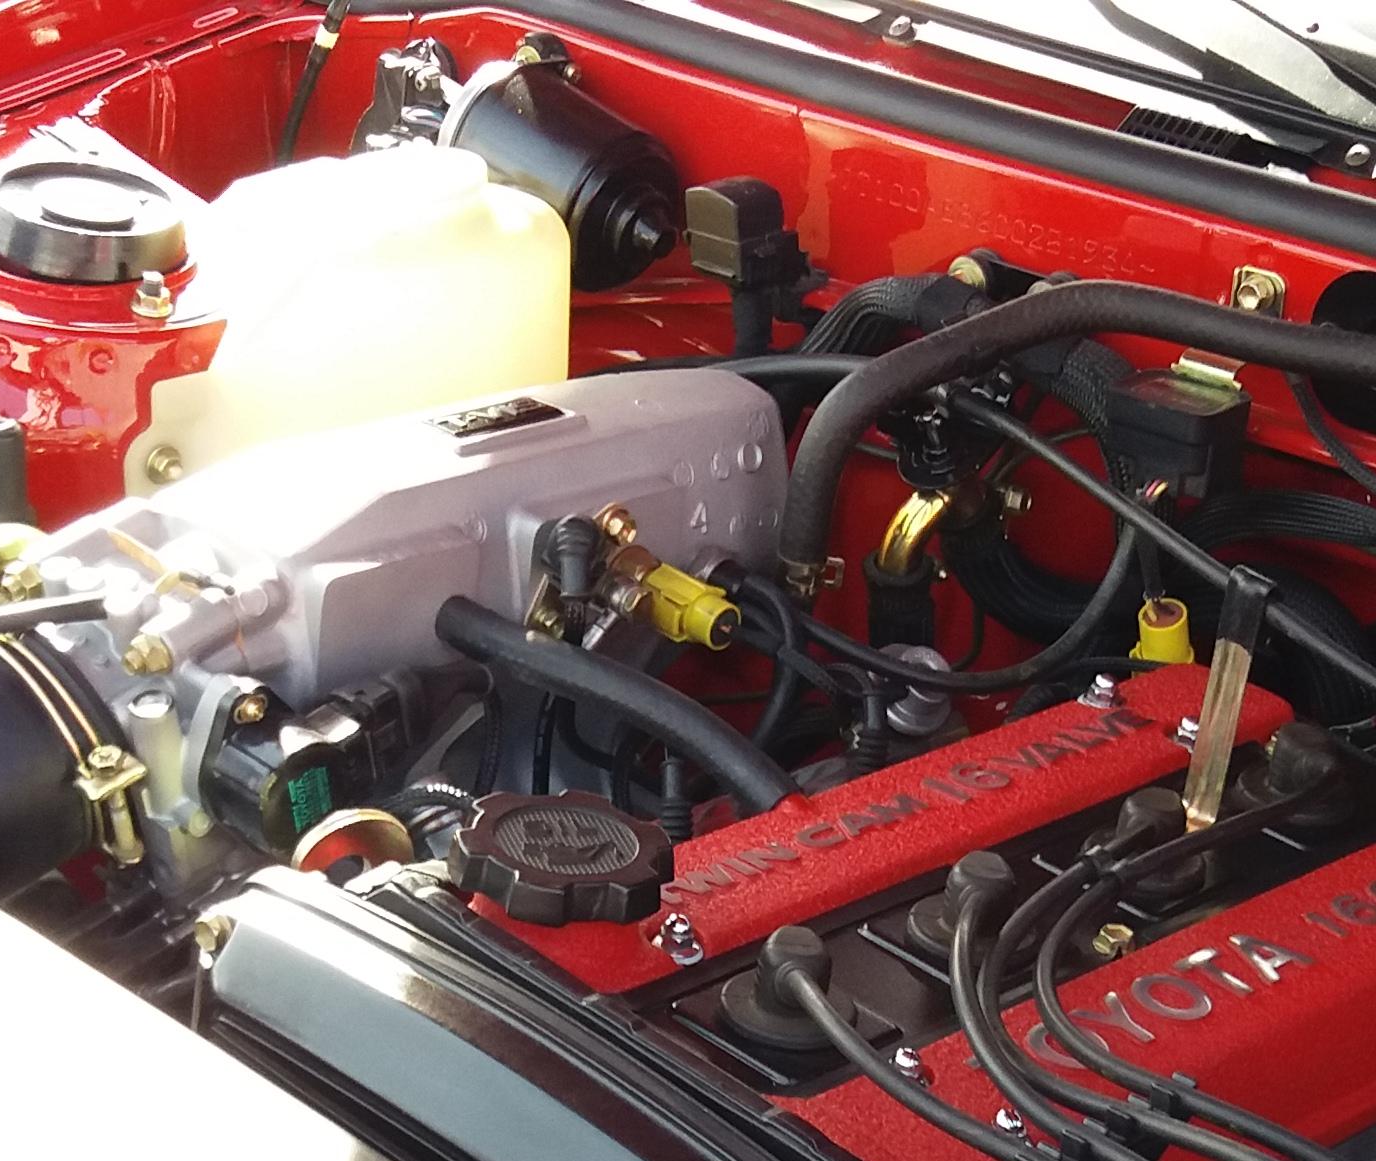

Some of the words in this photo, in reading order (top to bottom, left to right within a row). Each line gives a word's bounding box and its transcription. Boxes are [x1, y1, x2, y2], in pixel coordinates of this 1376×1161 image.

[659, 842, 799, 906] TWIN
[794, 791, 928, 850] CAM
[921, 760, 1013, 807] 16
[987, 708, 1158, 773] VALVE
[965, 932, 1316, 1072] OYOTA
